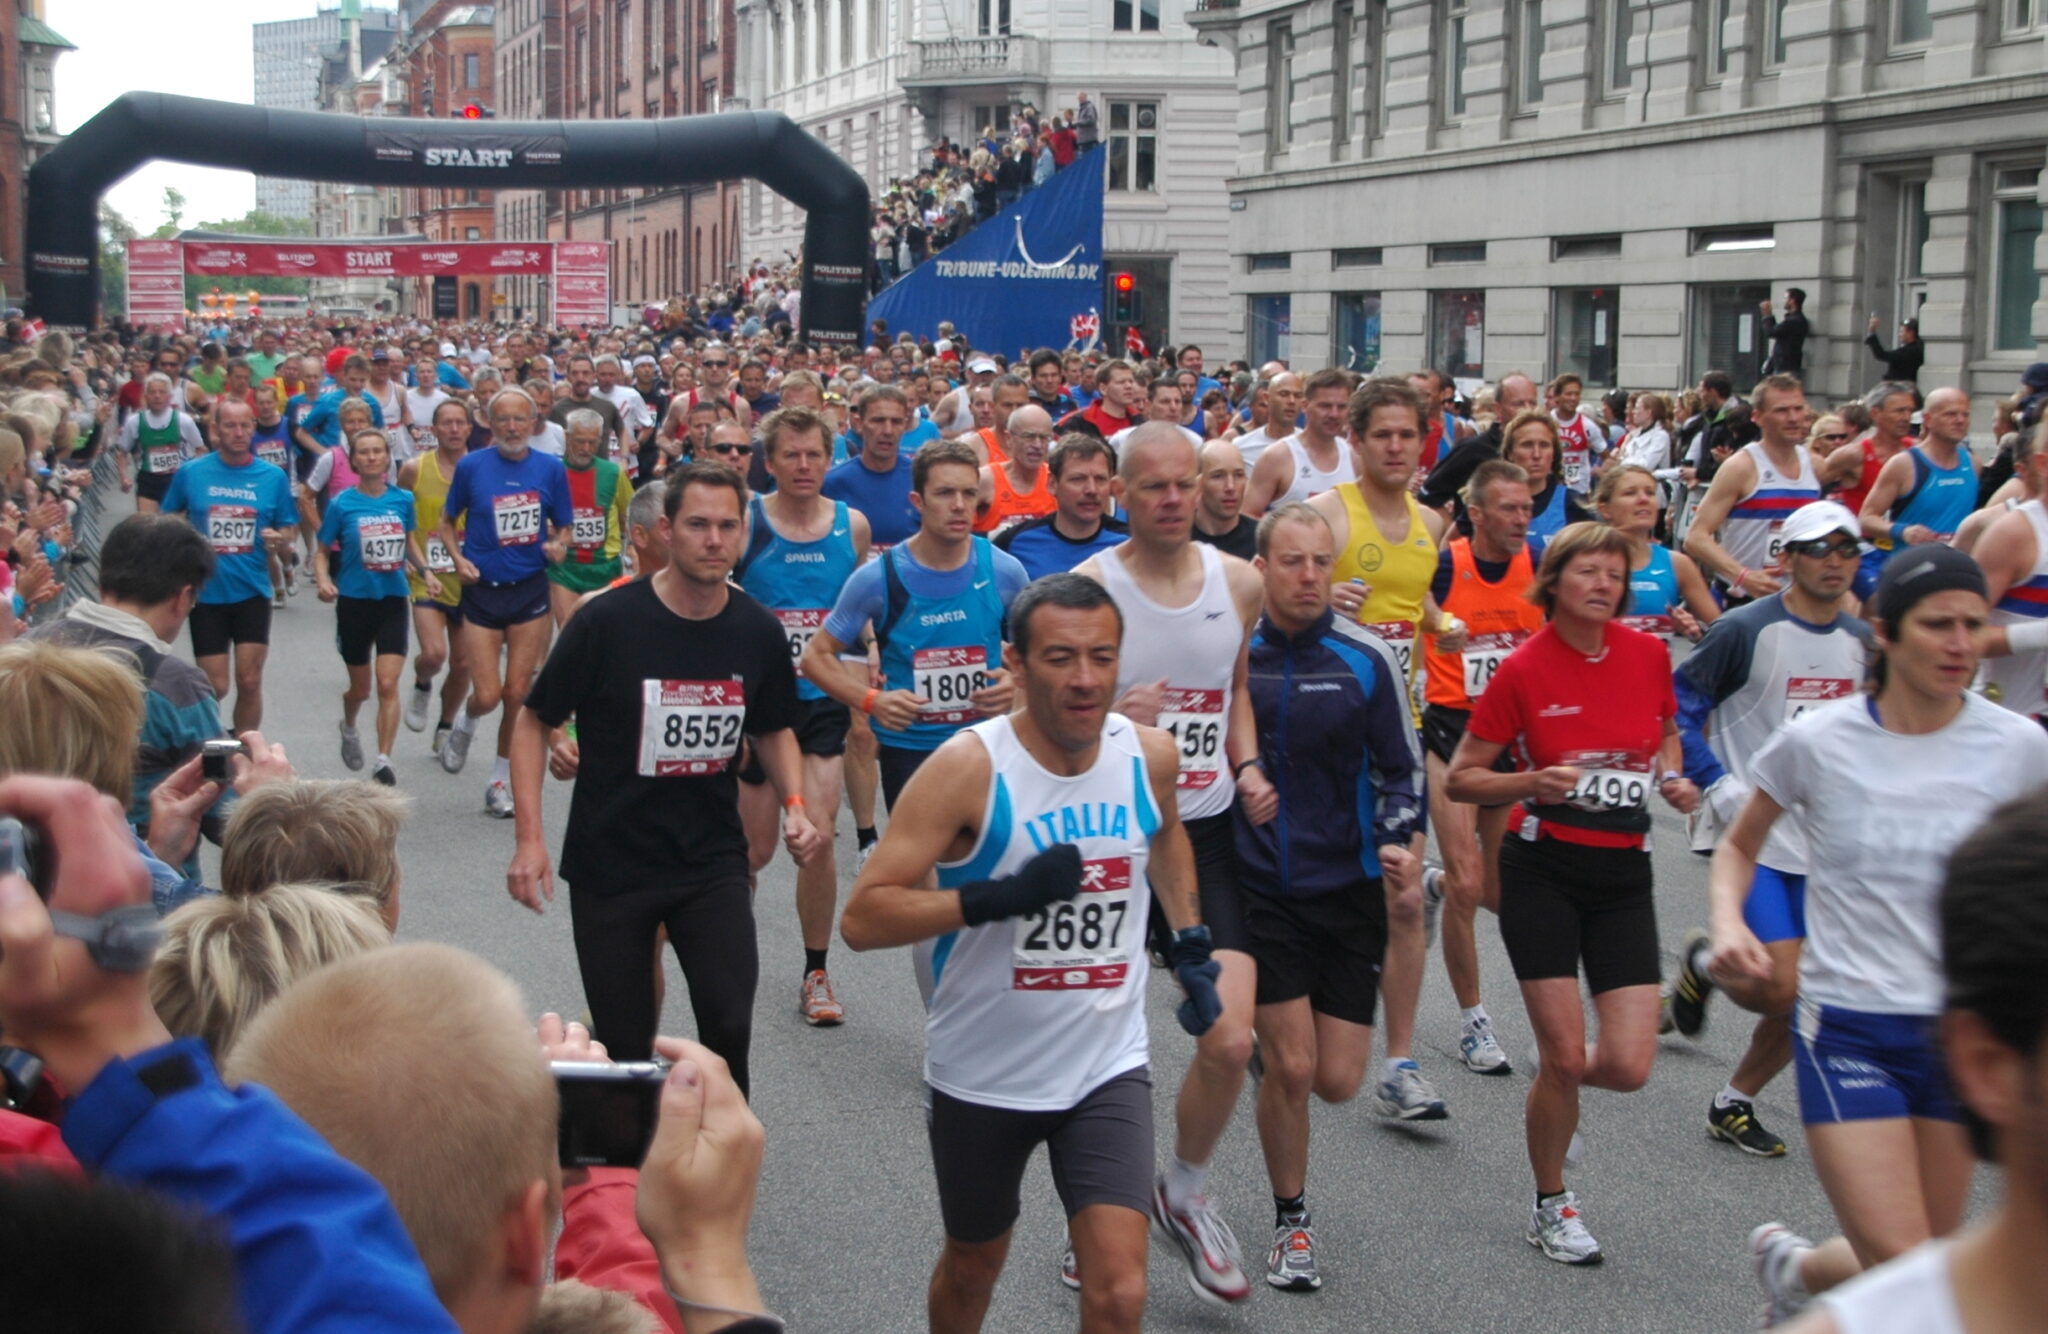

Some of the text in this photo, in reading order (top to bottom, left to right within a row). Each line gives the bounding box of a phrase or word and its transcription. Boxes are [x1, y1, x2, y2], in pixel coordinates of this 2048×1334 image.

[425, 148, 513, 168] START
[346, 251, 394, 267] START
[814, 264, 863, 275] POLITIKEN
[936, 260, 1099, 280] TRIBUNE-UDLEJNING.DK
[809, 330, 858, 340] POLITIKEN
[208, 485, 257, 501] SPARTA
[499, 508, 540, 532] 7275
[212, 521, 256, 540] 2607
[365, 539, 405, 559] 4377
[431, 546, 449, 562] 69
[784, 552, 825, 564] SPARTA
[920, 609, 968, 627] SPARTA
[1469, 657, 1499, 686] 78
[921, 670, 986, 703] 1808
[664, 713, 741, 749] 8552
[1564, 774, 1644, 809] 499
[1025, 802, 1129, 854] ITALIA
[1024, 901, 1128, 951] 2687
